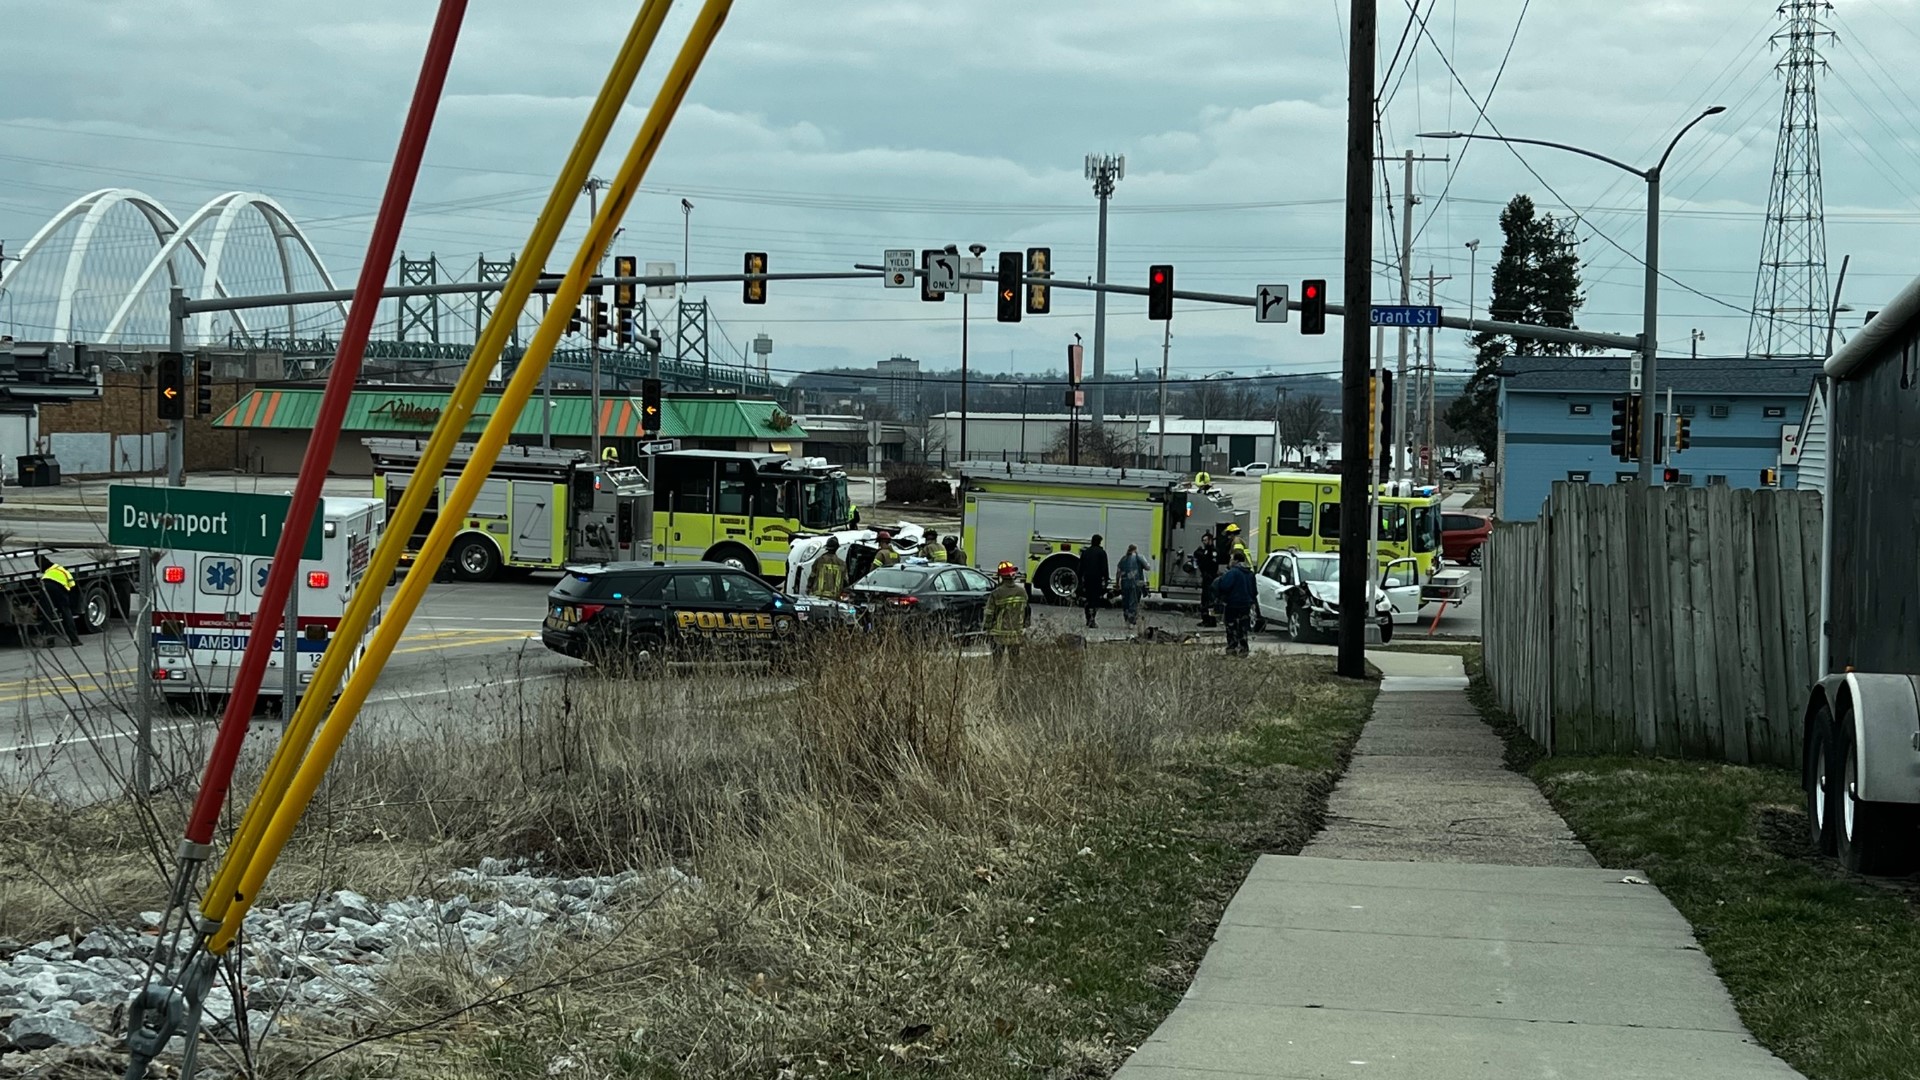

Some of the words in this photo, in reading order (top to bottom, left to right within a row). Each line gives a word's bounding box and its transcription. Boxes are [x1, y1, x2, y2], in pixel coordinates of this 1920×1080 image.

[890, 258, 909, 267] YIELD
[932, 281, 955, 289] ONLY
[1370, 309, 1410, 323] Grant
[1417, 309, 1432, 323] St
[123, 504, 228, 537] Davenport
[260, 513, 267, 537] 1
[674, 611, 774, 631] POLICE
[197, 635, 285, 651] AMBULC
